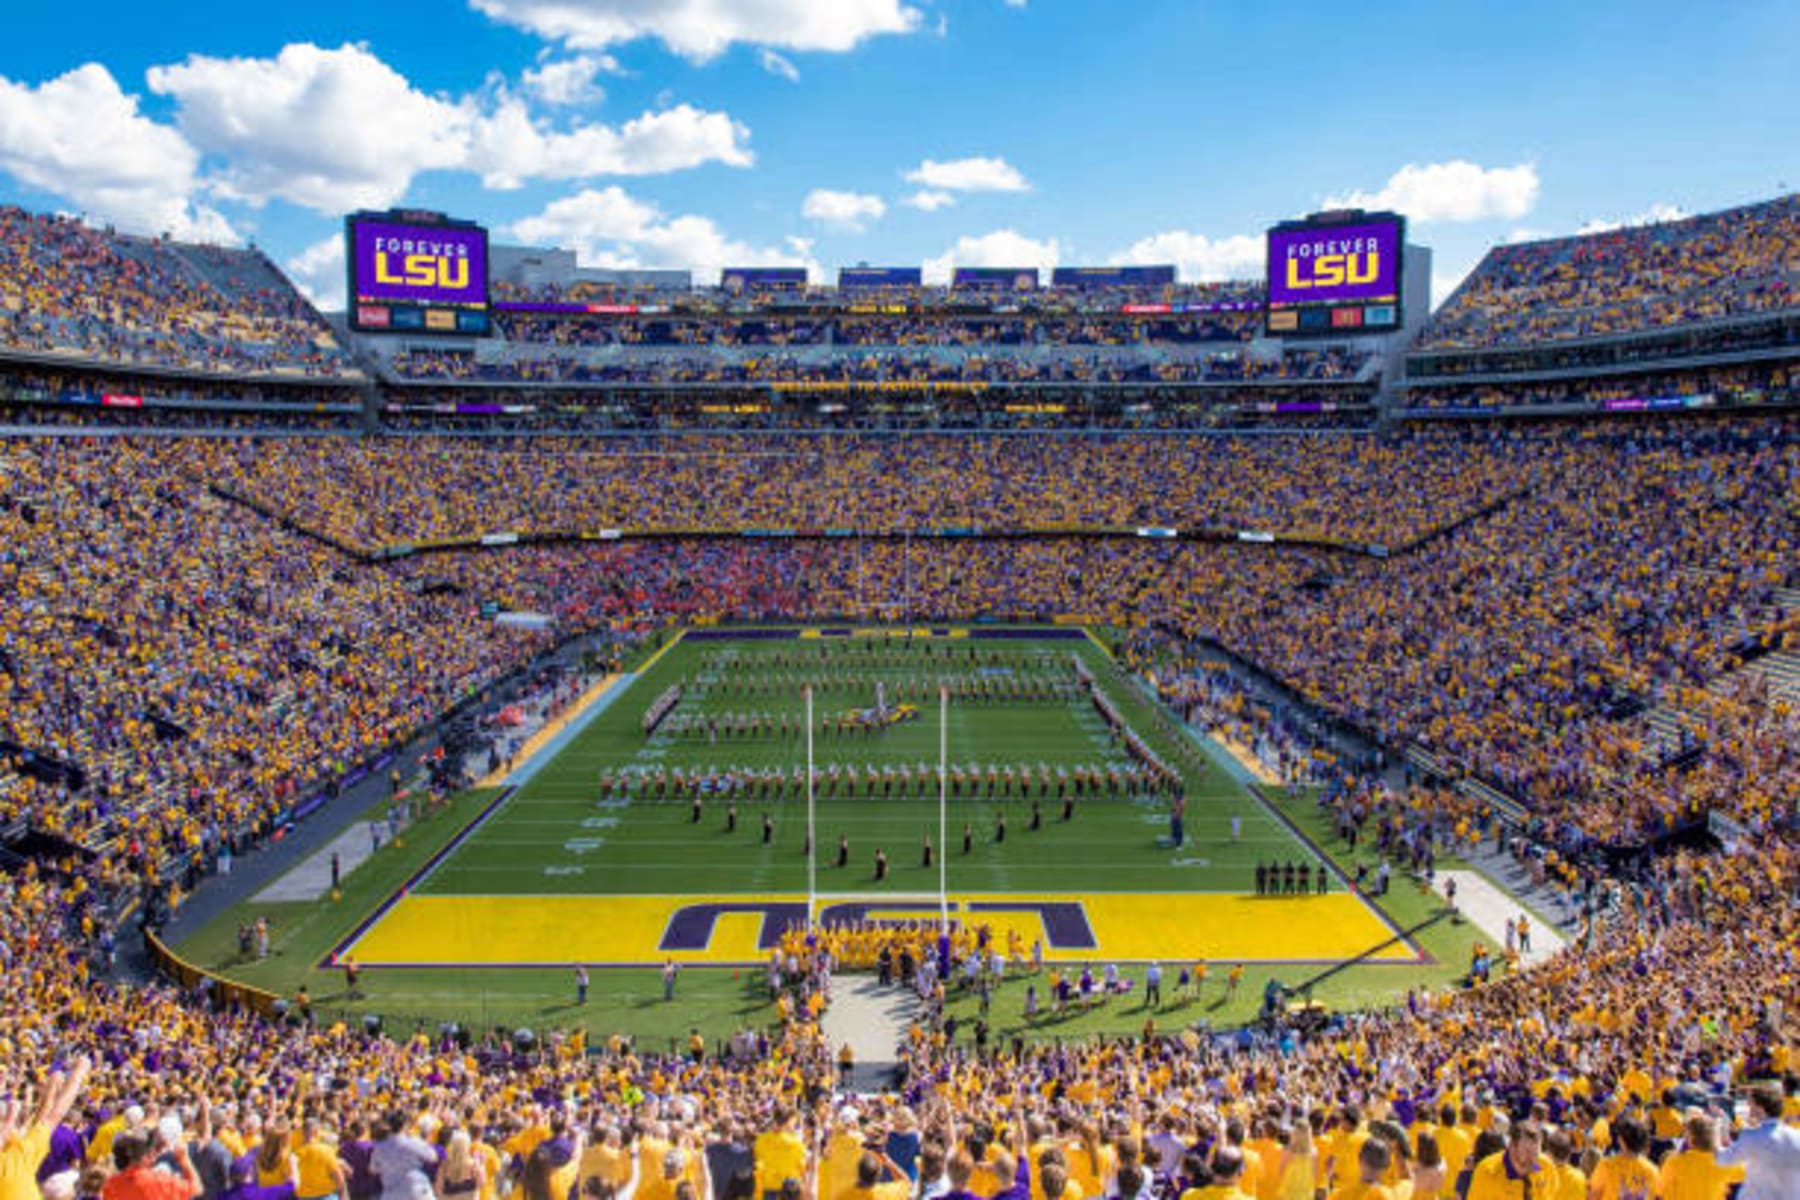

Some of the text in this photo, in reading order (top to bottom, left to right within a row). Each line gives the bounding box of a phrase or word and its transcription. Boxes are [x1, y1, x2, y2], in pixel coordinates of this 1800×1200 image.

[375, 237, 467, 257] FOREVER
[1287, 237, 1378, 258] FOREVER
[376, 252, 469, 288] LSU
[1286, 252, 1379, 289] LSU
